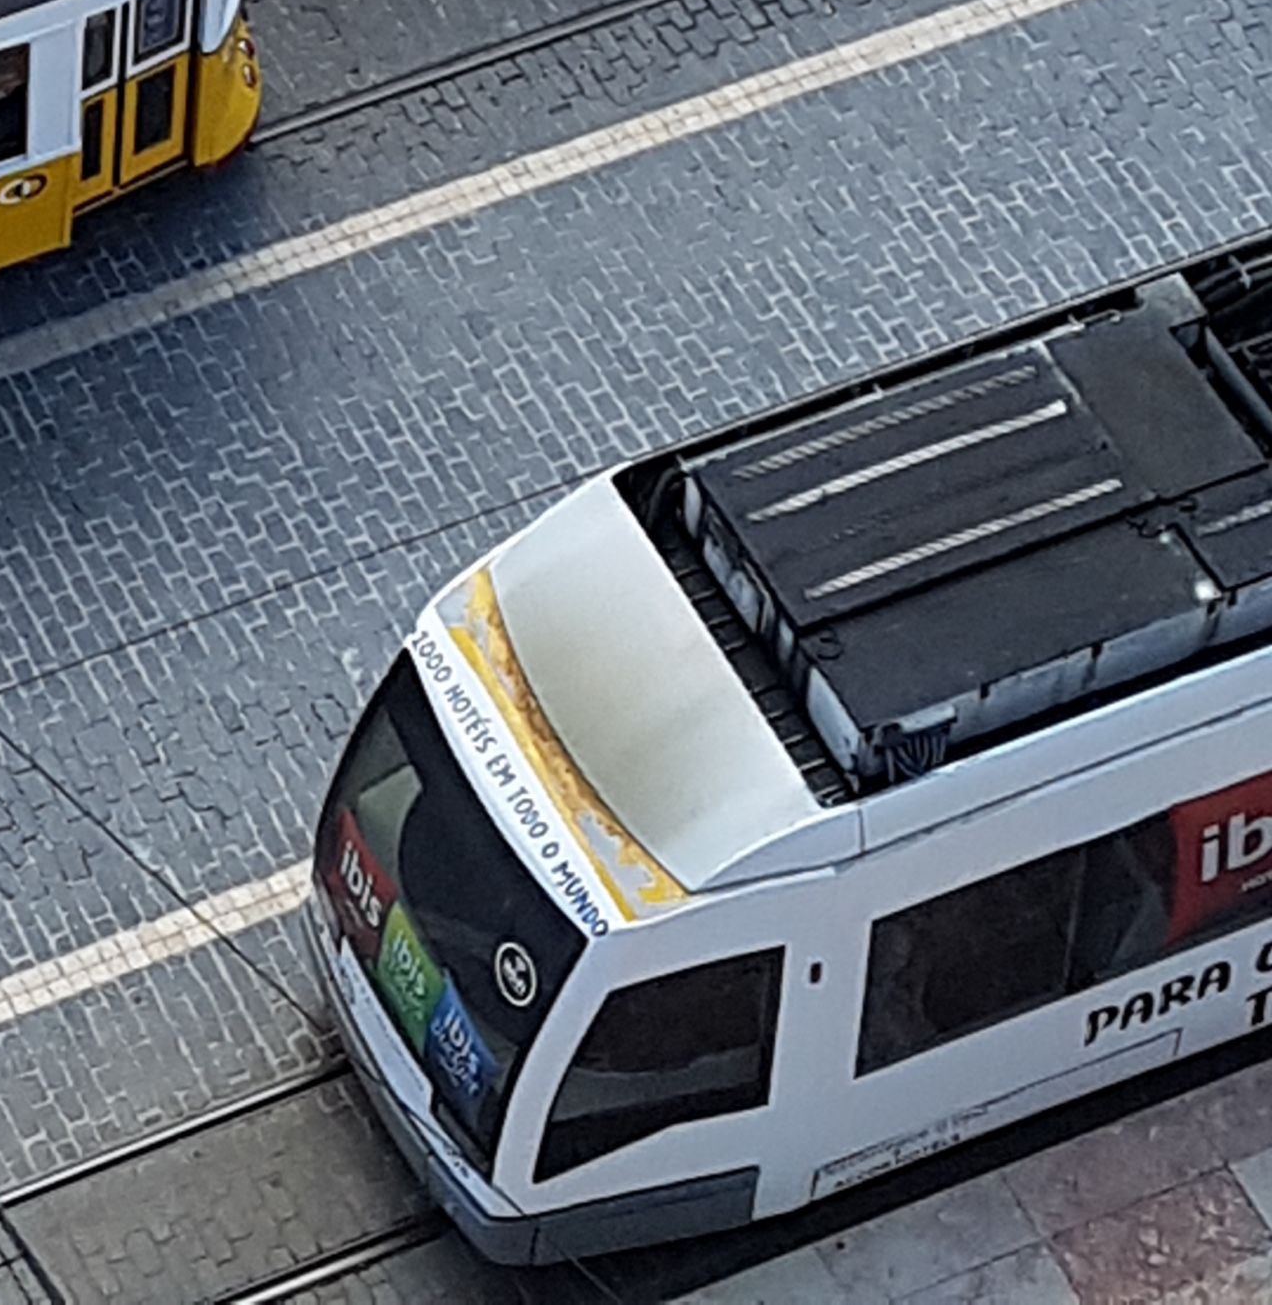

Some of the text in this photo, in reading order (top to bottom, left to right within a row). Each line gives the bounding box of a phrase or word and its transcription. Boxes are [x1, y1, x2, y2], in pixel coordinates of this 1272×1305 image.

[411, 630, 610, 938] 1000 HOTÉIS EM TODO O MUNDO
[340, 841, 383, 928] ibis
[393, 930, 427, 996] ibis
[1083, 960, 1232, 1047] PARA
[444, 1006, 480, 1075] ibis
